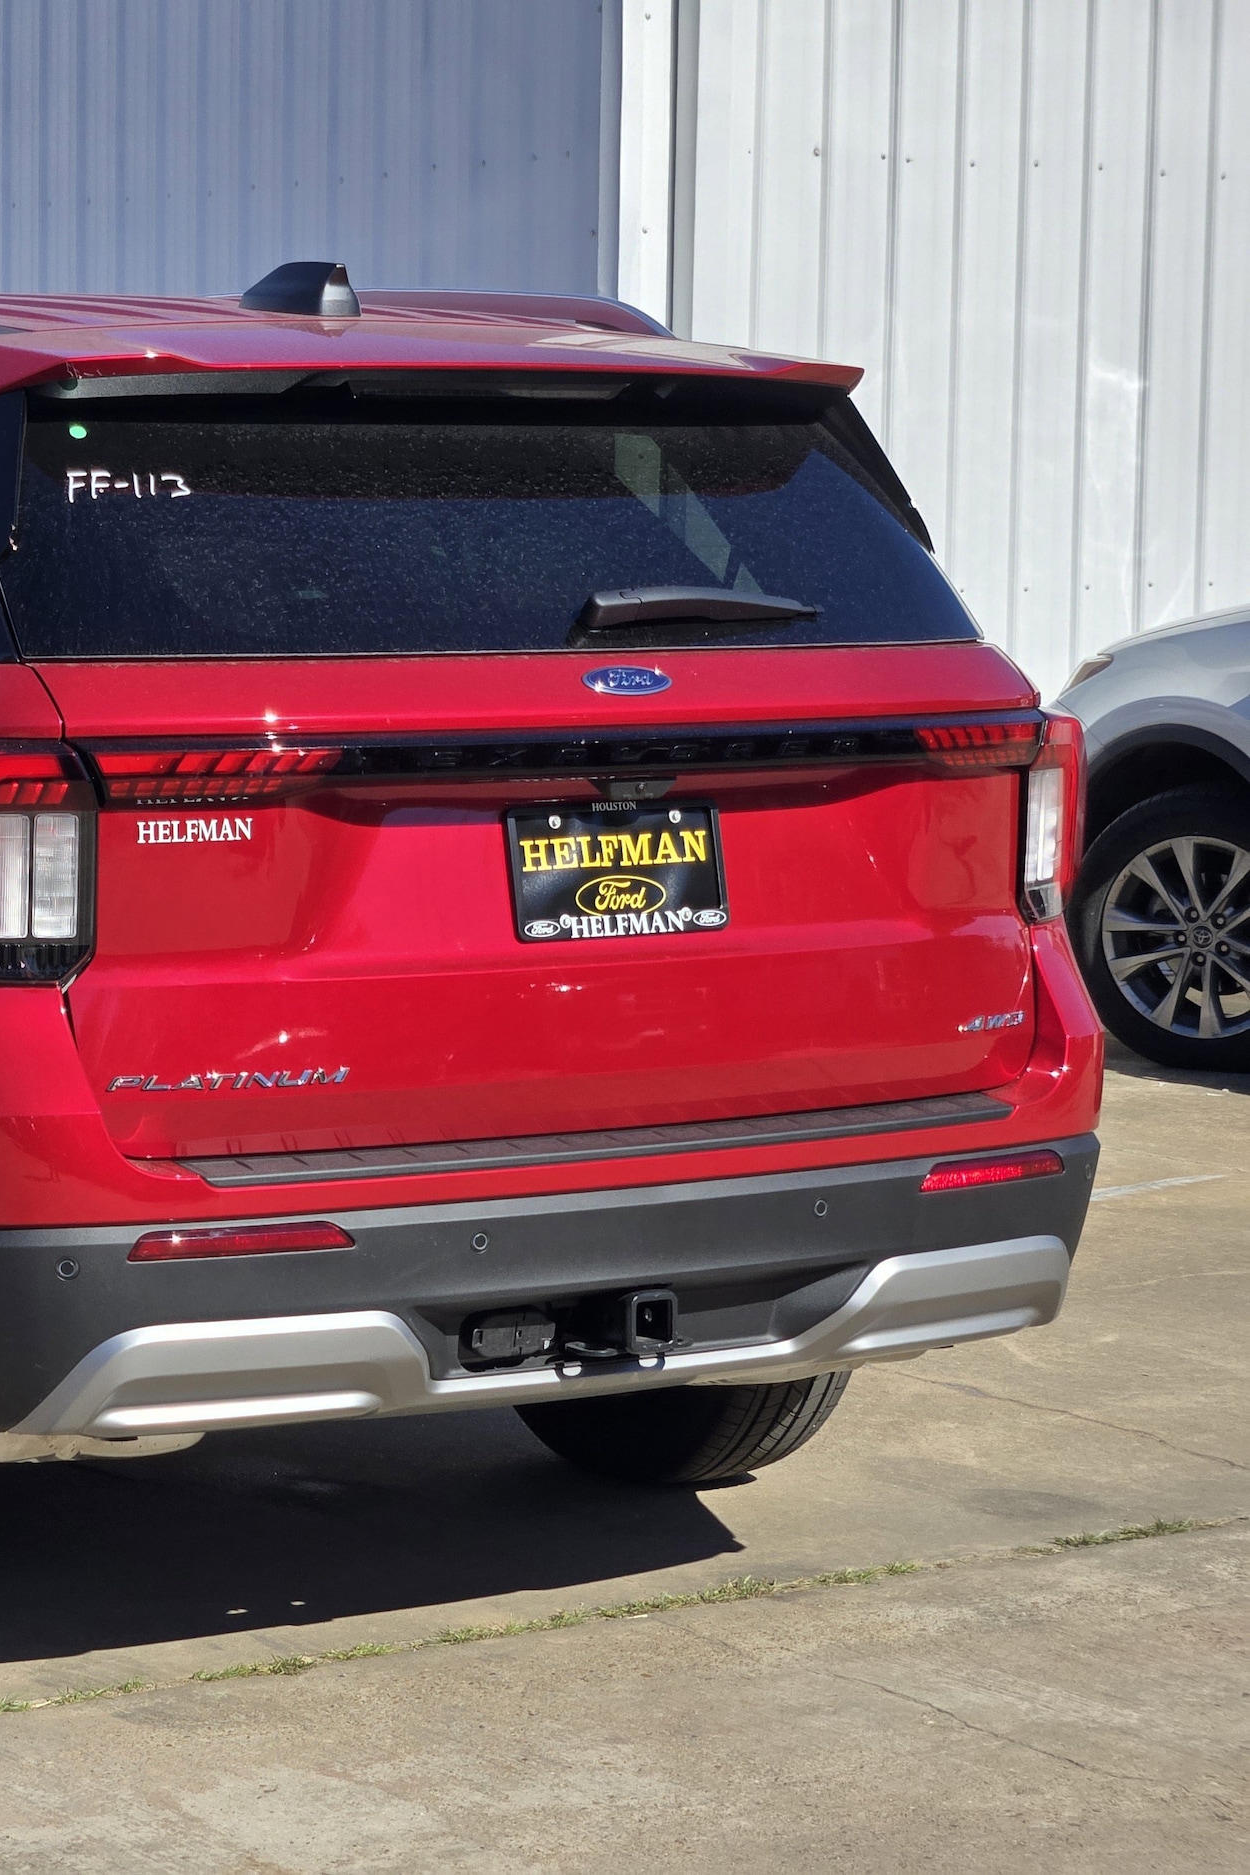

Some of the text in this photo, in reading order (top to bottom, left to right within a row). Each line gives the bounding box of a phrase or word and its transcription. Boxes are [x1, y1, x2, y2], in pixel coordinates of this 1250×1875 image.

[607, 668, 654, 687] Ford
[591, 801, 638, 812] HOUSTON
[136, 817, 254, 844] HELFMAN
[519, 830, 706, 872] HELFMAN
[594, 879, 647, 911] Ford
[570, 910, 684, 939] HELFMAN
[106, 1066, 351, 1092] PLATINUM
